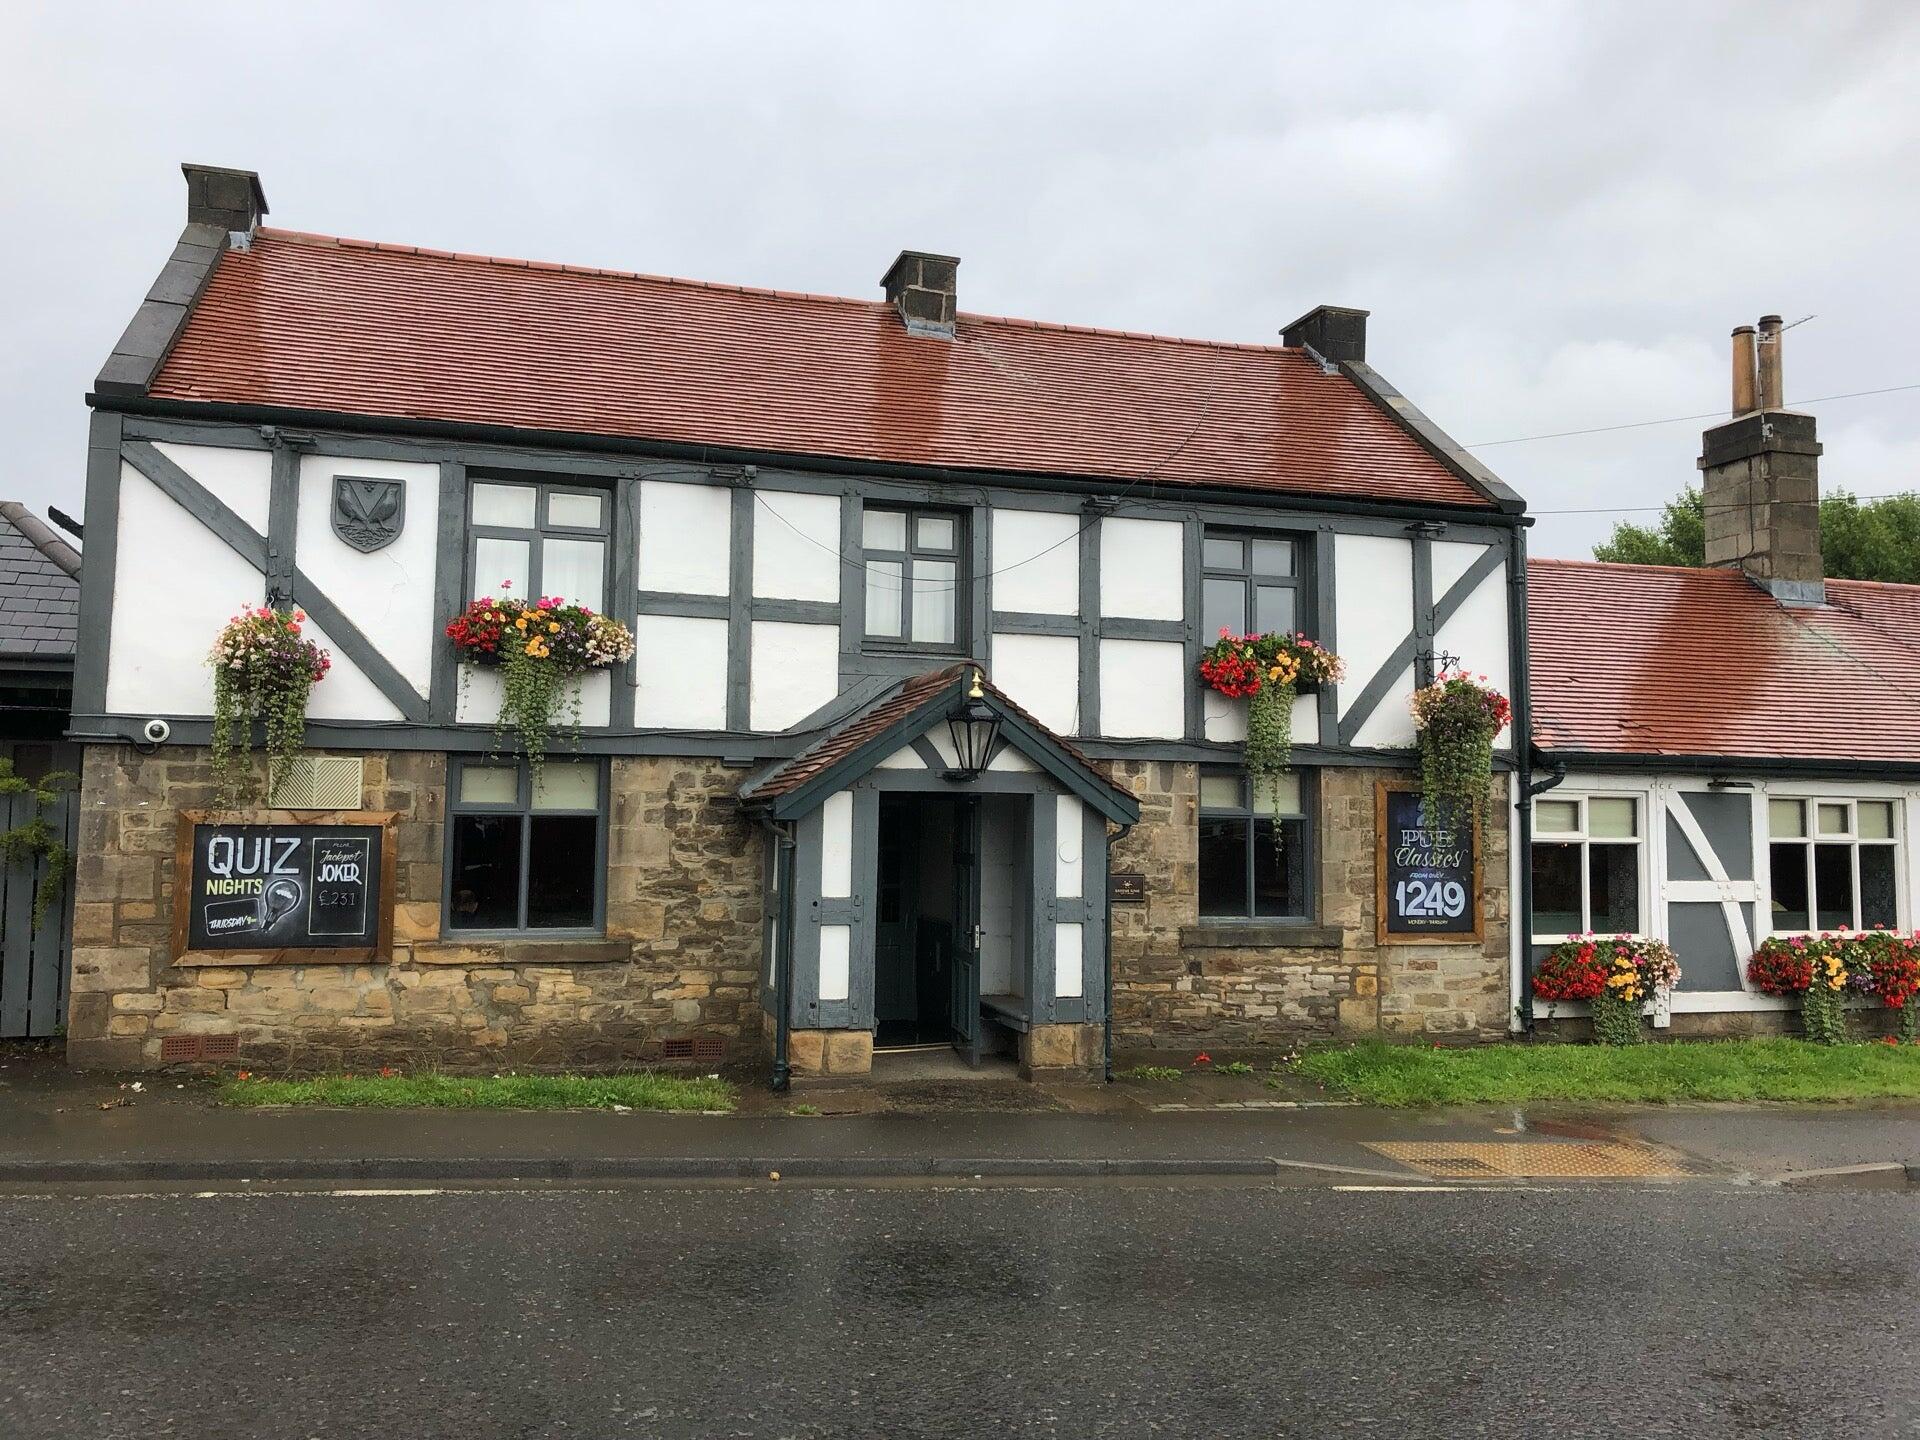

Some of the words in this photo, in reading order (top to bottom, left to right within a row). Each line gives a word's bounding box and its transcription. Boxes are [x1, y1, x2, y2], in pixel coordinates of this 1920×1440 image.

[208, 837, 301, 878] QUIZ
[320, 849, 365, 863] Jackpot
[1395, 847, 1468, 868] Classics
[317, 863, 362, 885] JOKER
[206, 879, 264, 895] NIGHTS
[319, 890, 355, 906] £231
[1395, 880, 1465, 917] 12.49
[209, 915, 248, 929] THURSDAY
